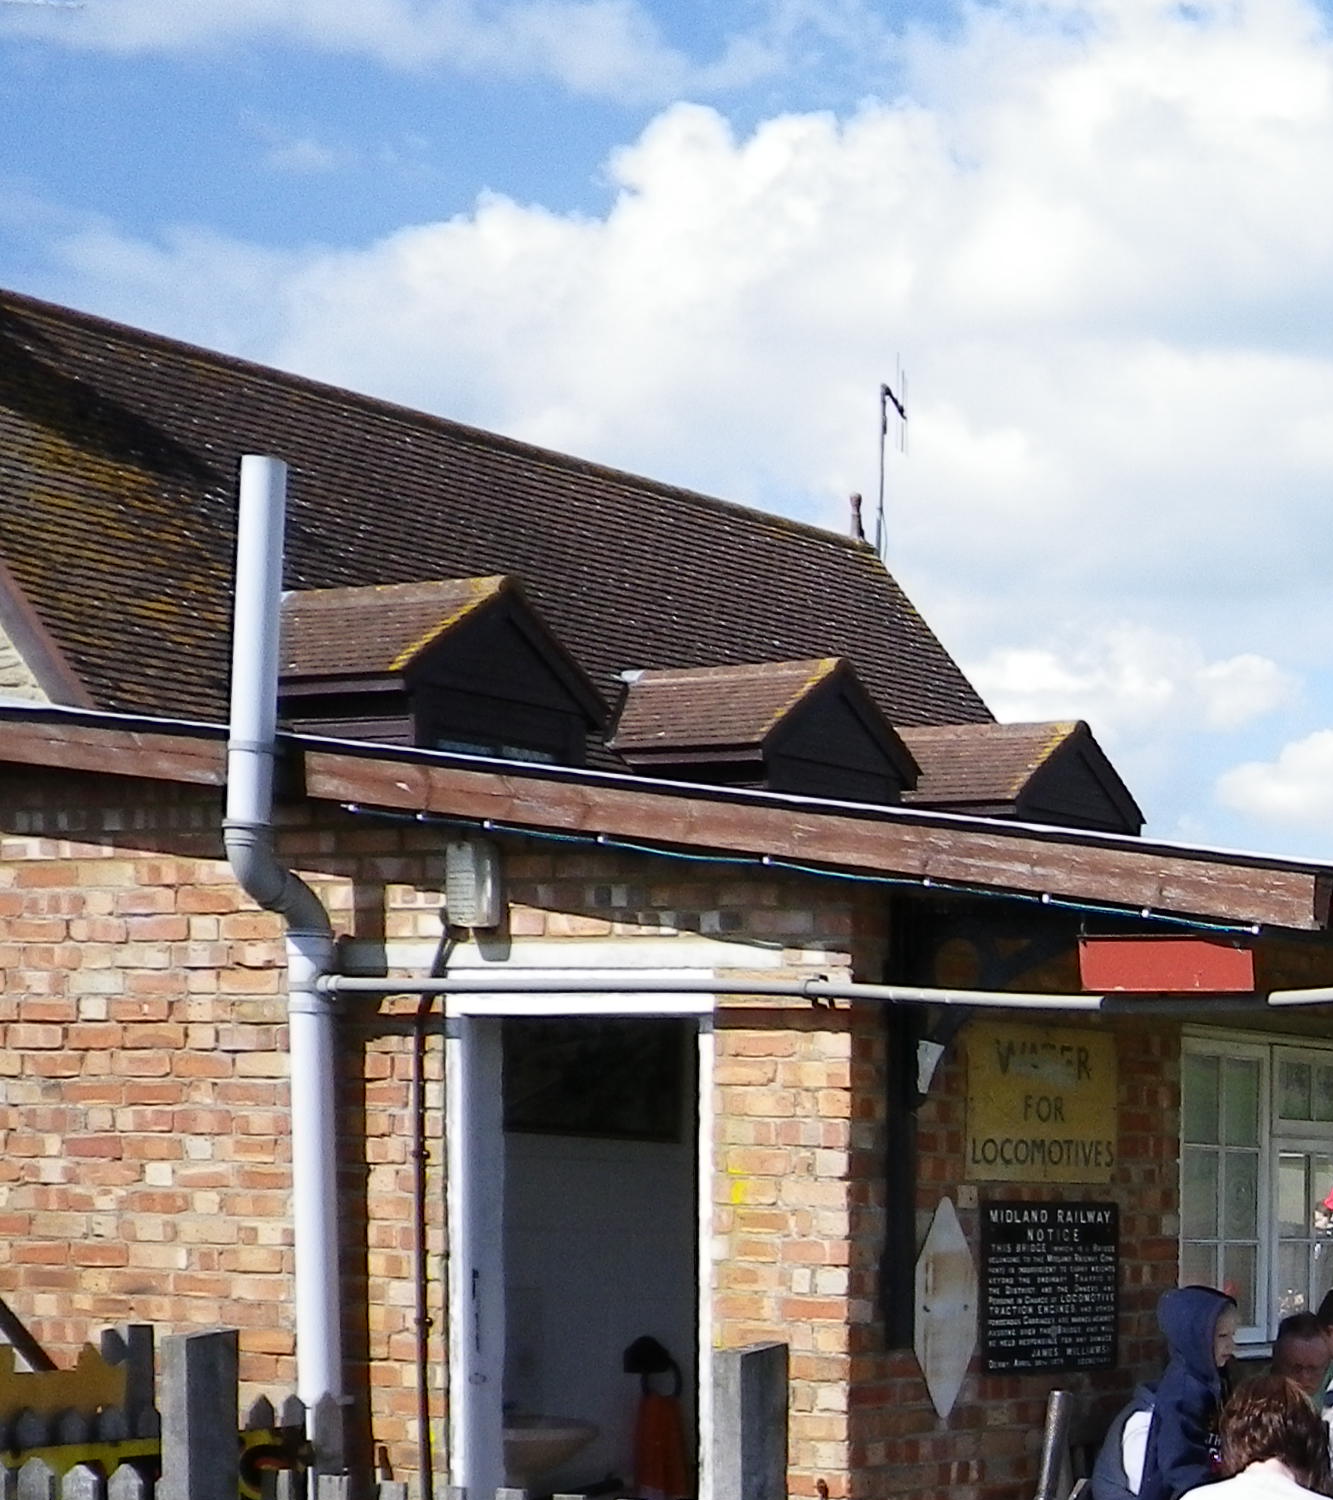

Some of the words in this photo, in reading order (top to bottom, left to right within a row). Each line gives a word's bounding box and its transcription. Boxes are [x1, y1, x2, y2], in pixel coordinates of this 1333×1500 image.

[1023, 1094, 1065, 1123] FOR
[971, 1137, 1114, 1168] LOCOMOTIVES
[989, 1209, 1048, 1224] MIDLAND
[1057, 1209, 1111, 1224] RAILWAY
[1027, 1228, 1080, 1242] NOTICE
[991, 1244, 1012, 1253] THIS
[1016, 1243, 1046, 1253] BRIDGE
[989, 1306, 1033, 1315] TRACTION
[1037, 1304, 1075, 1314] ENGINES
[1031, 1347, 1059, 1357] JAMES
